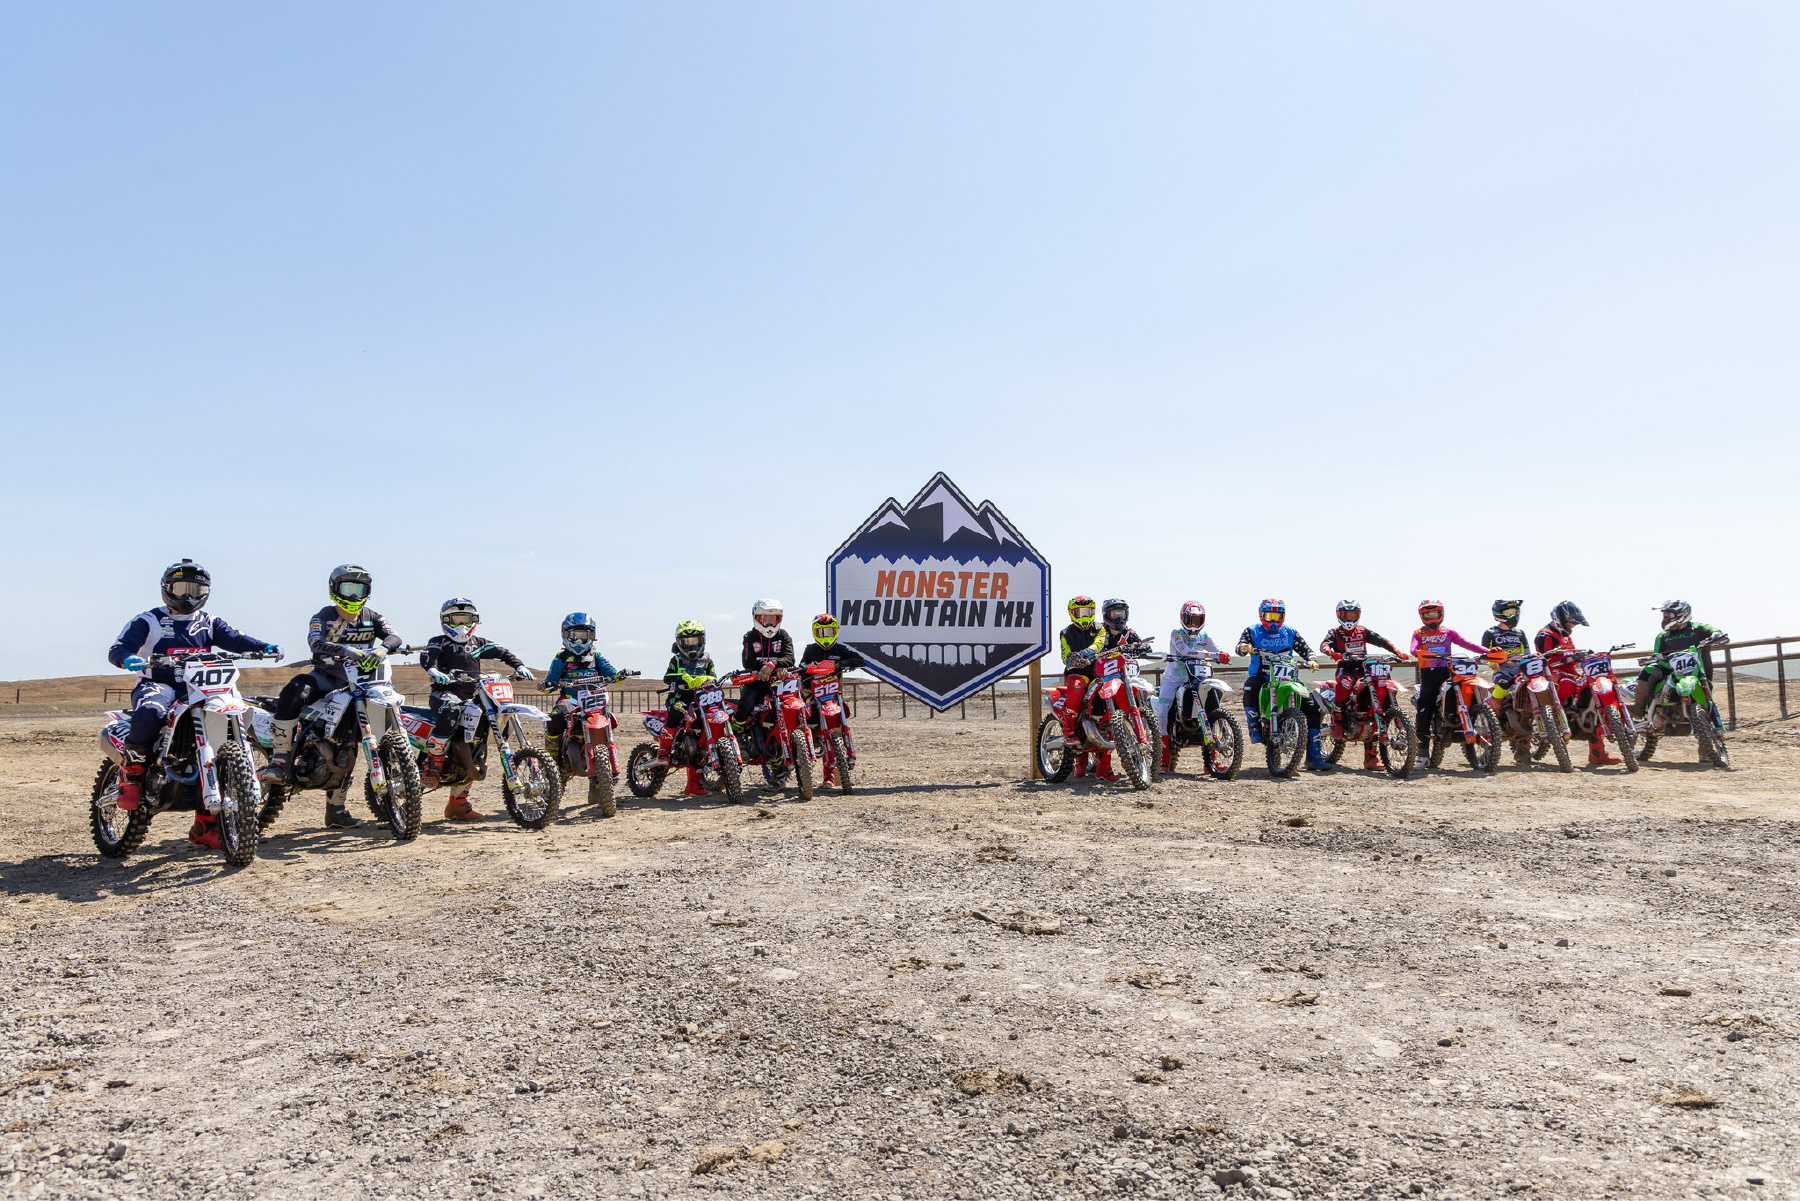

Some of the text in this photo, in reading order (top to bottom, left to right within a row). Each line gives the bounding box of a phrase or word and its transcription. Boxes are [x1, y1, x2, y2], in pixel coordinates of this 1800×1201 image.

[875, 570, 1009, 600] MONSTER
[841, 600, 1034, 627] MOUNTAIN MX
[1103, 659, 1119, 676] 2
[1526, 659, 1544, 676] 8
[1675, 657, 1697, 671] 414
[189, 668, 236, 687] 407
[1274, 665, 1295, 680] 714
[775, 680, 799, 696] 14
[814, 682, 839, 698] 512
[580, 694, 607, 709] 125
